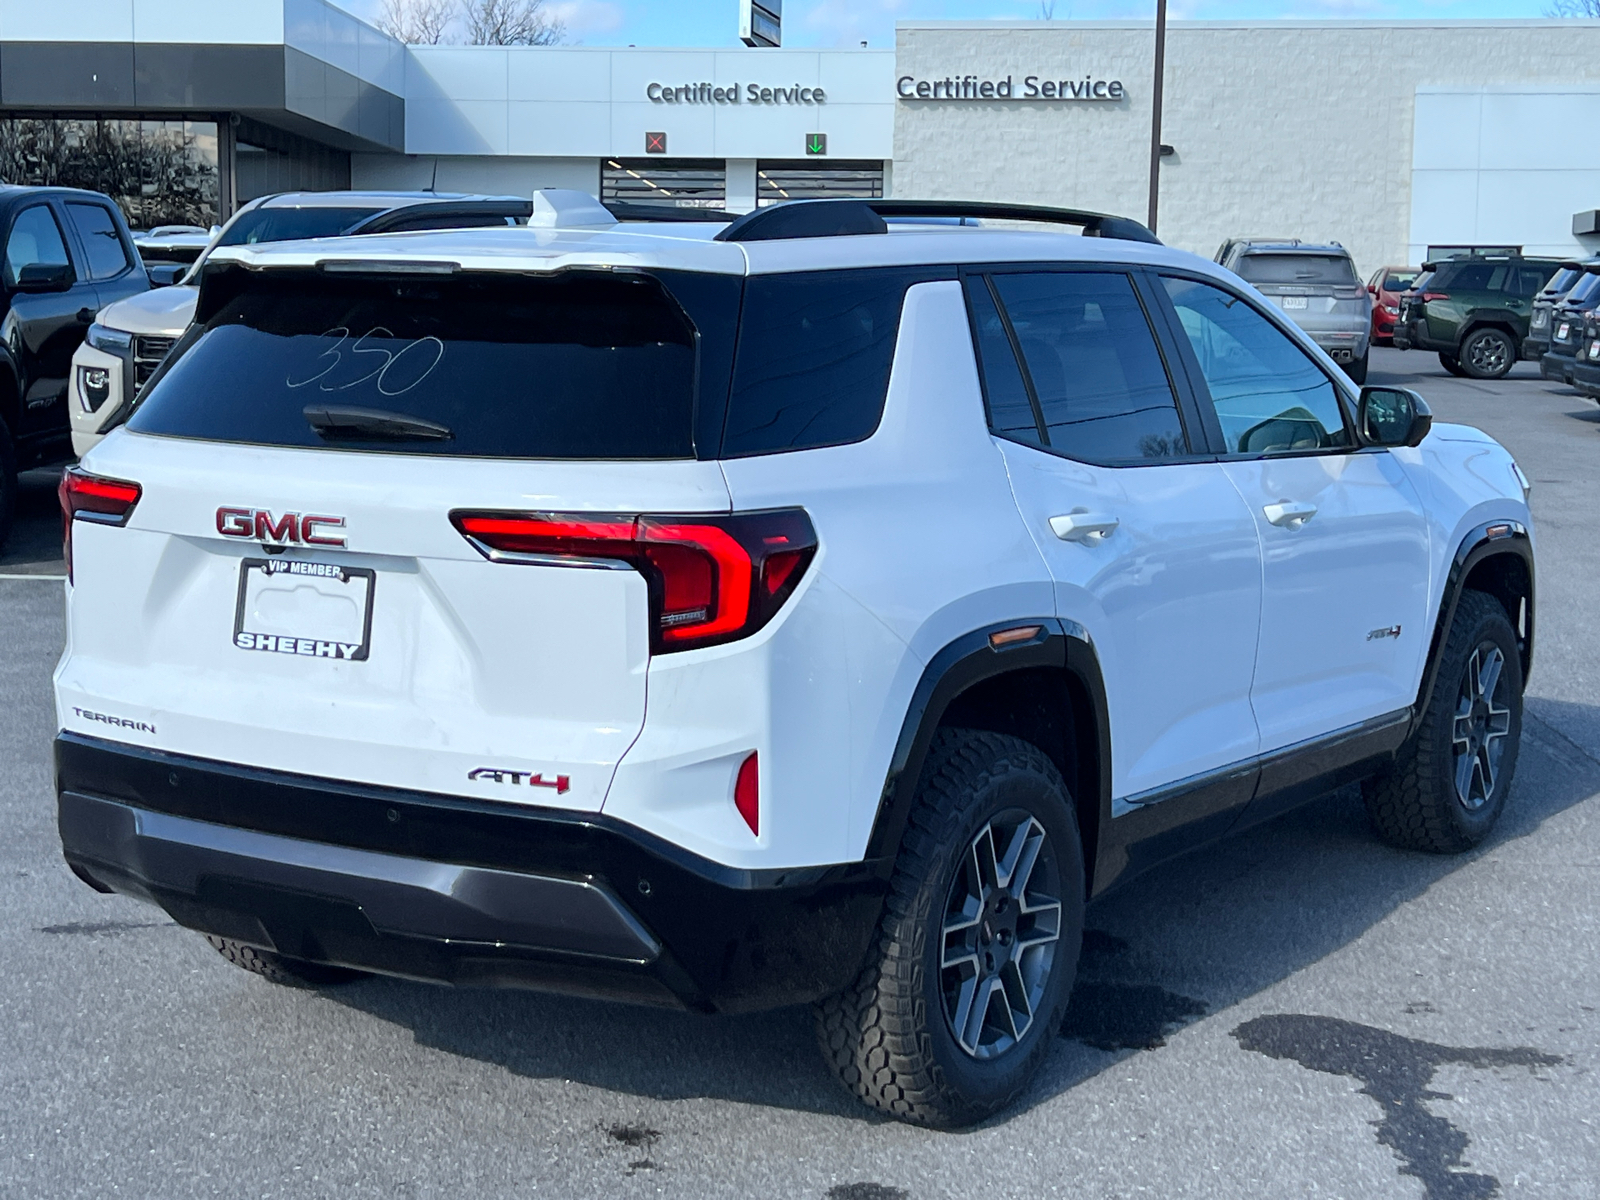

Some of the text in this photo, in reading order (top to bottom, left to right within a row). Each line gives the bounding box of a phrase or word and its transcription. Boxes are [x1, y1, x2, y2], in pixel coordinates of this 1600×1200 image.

[646, 82, 826, 103] Certified Service
[896, 74, 1124, 99] Certified Service
[286, 326, 444, 396] 350
[215, 504, 348, 550] GMC
[268, 559, 341, 577] VIP MEMBER
[236, 632, 359, 660] SHEEHY
[72, 706, 157, 735] TERRAIN
[467, 766, 570, 795] AT4
